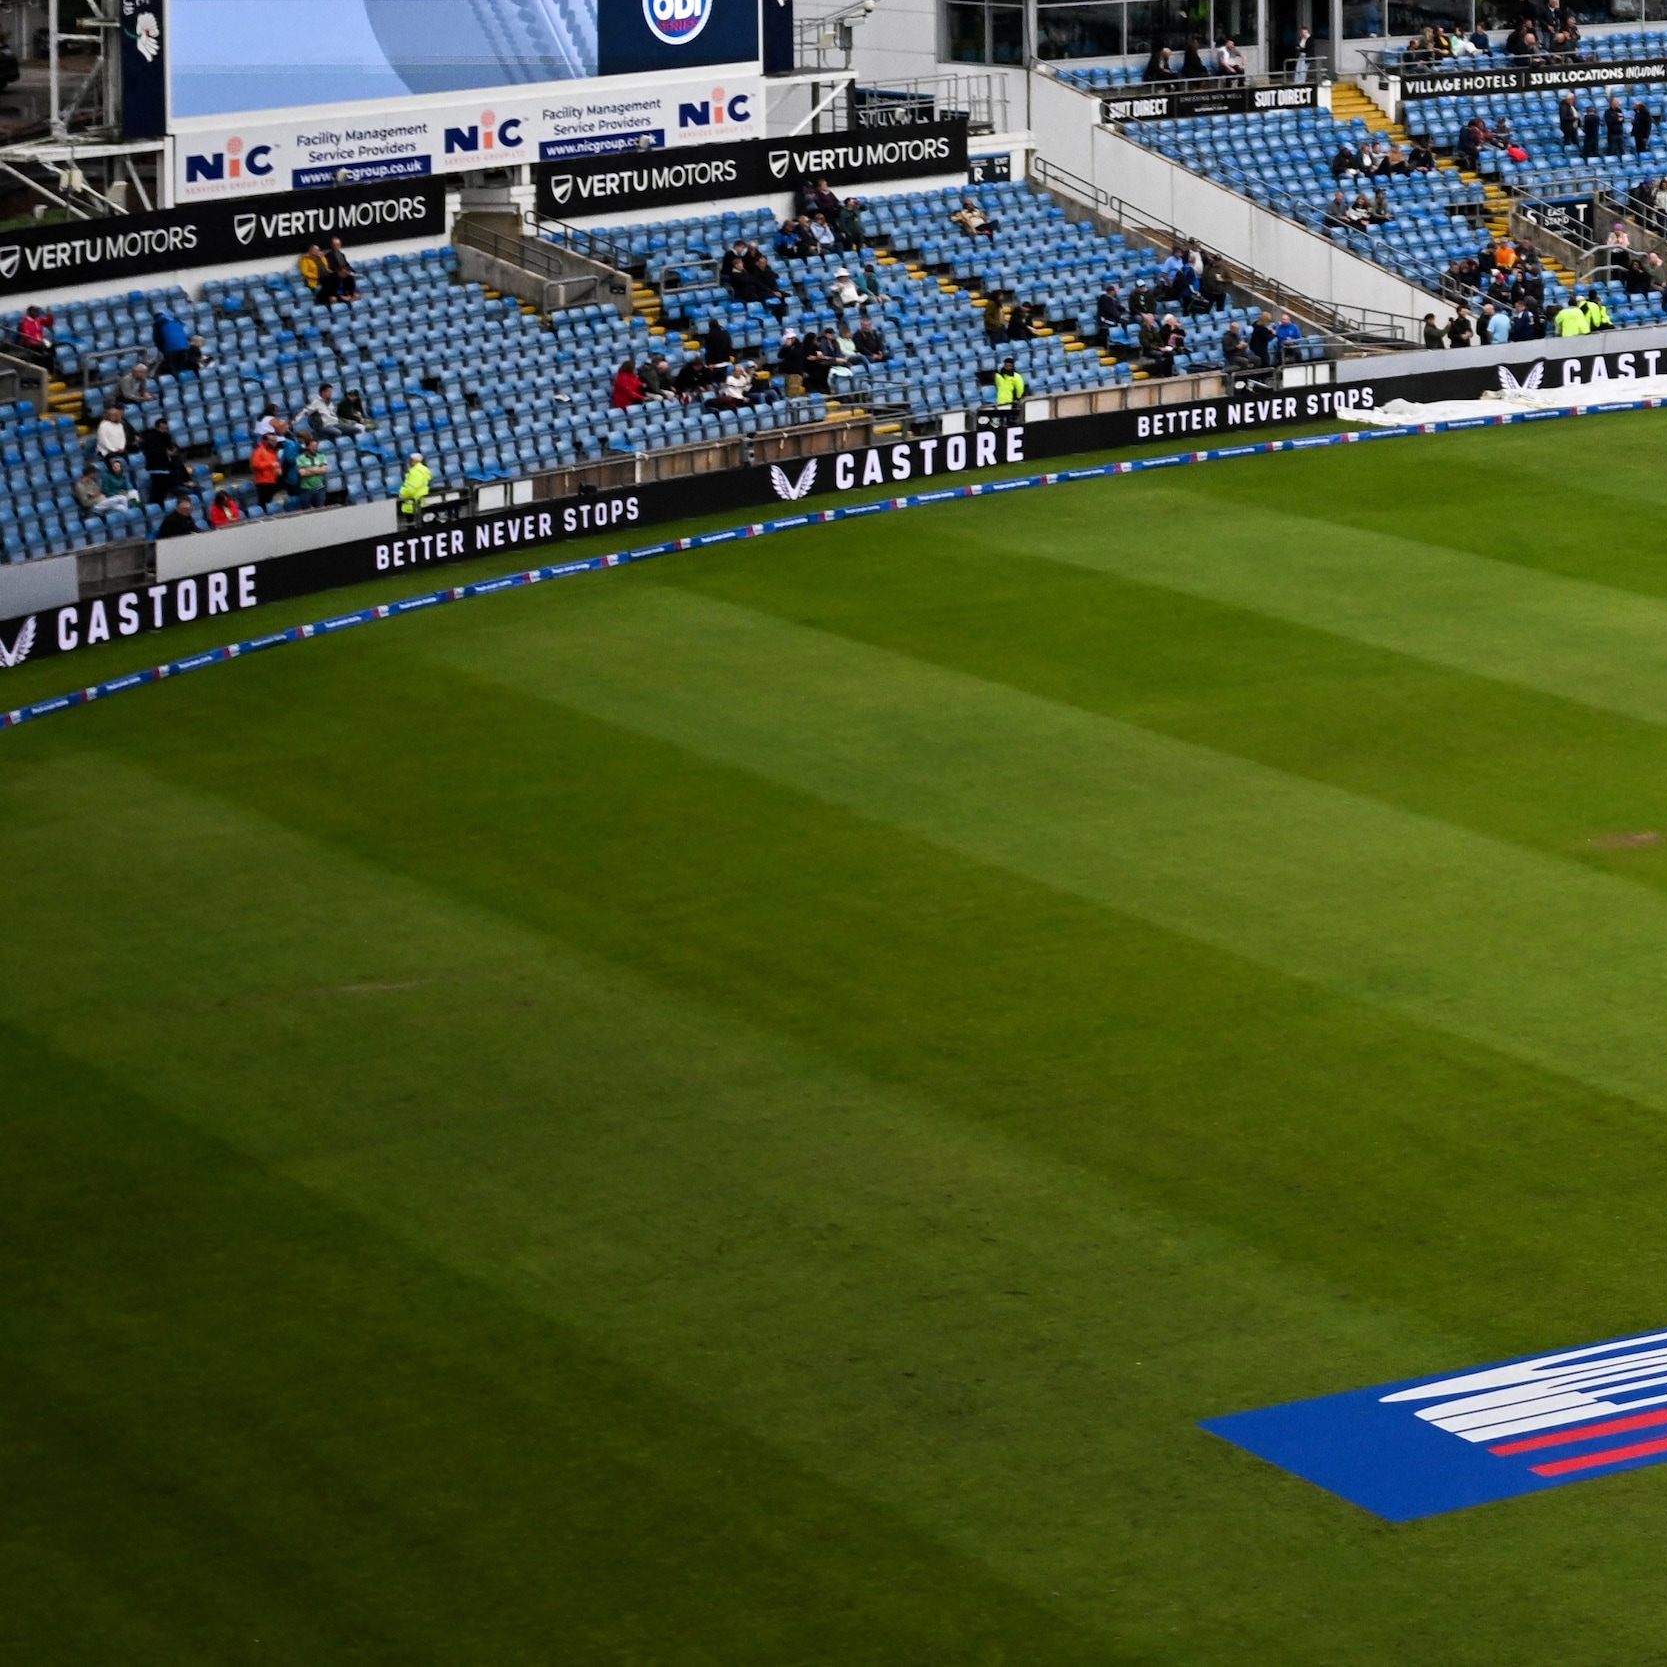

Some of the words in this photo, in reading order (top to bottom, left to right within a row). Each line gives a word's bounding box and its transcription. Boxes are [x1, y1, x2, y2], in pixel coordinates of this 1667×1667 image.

[1406, 78, 1462, 95] VILLAGE
[1464, 74, 1518, 92] HOTELS
[1530, 72, 1543, 85] 33
[1544, 71, 1561, 84] UK
[1562, 66, 1624, 84] LOCATIONS
[1626, 64, 1666, 80] INCLUDING
[542, 107, 582, 121] Facility
[586, 98, 662, 118] Management
[1109, 101, 1132, 118] SUIT
[1133, 98, 1169, 117] DIRECT
[1254, 90, 1276, 108] SUIT
[1278, 88, 1313, 106] DIRECT
[297, 132, 341, 148] Facility
[345, 123, 428, 144] Management
[554, 122, 596, 136] Service
[598, 115, 651, 130] Providers
[308, 148, 355, 163] Service
[358, 140, 417, 159] Providers
[793, 145, 864, 174] VERTU
[866, 137, 950, 166] MOTORS
[576, 168, 649, 199] VERTU
[652, 160, 737, 190] MOTORS
[974, 168, 984, 182] R
[260, 208, 334, 240] VERTU
[338, 196, 427, 228] MOTORS
[1575, 204, 1588, 222] T
[25, 238, 101, 272] VERTU
[105, 225, 198, 259] MOTORS
[1137, 406, 1218, 438] BETTER
[1227, 396, 1298, 424] NEVER
[1306, 386, 1374, 416] STOPS
[835, 426, 1024, 490] CASTORE
[376, 530, 465, 571] BETTER
[476, 511, 554, 551] NEVER
[563, 497, 640, 534] STOPS
[56, 564, 258, 652] CASTORE
